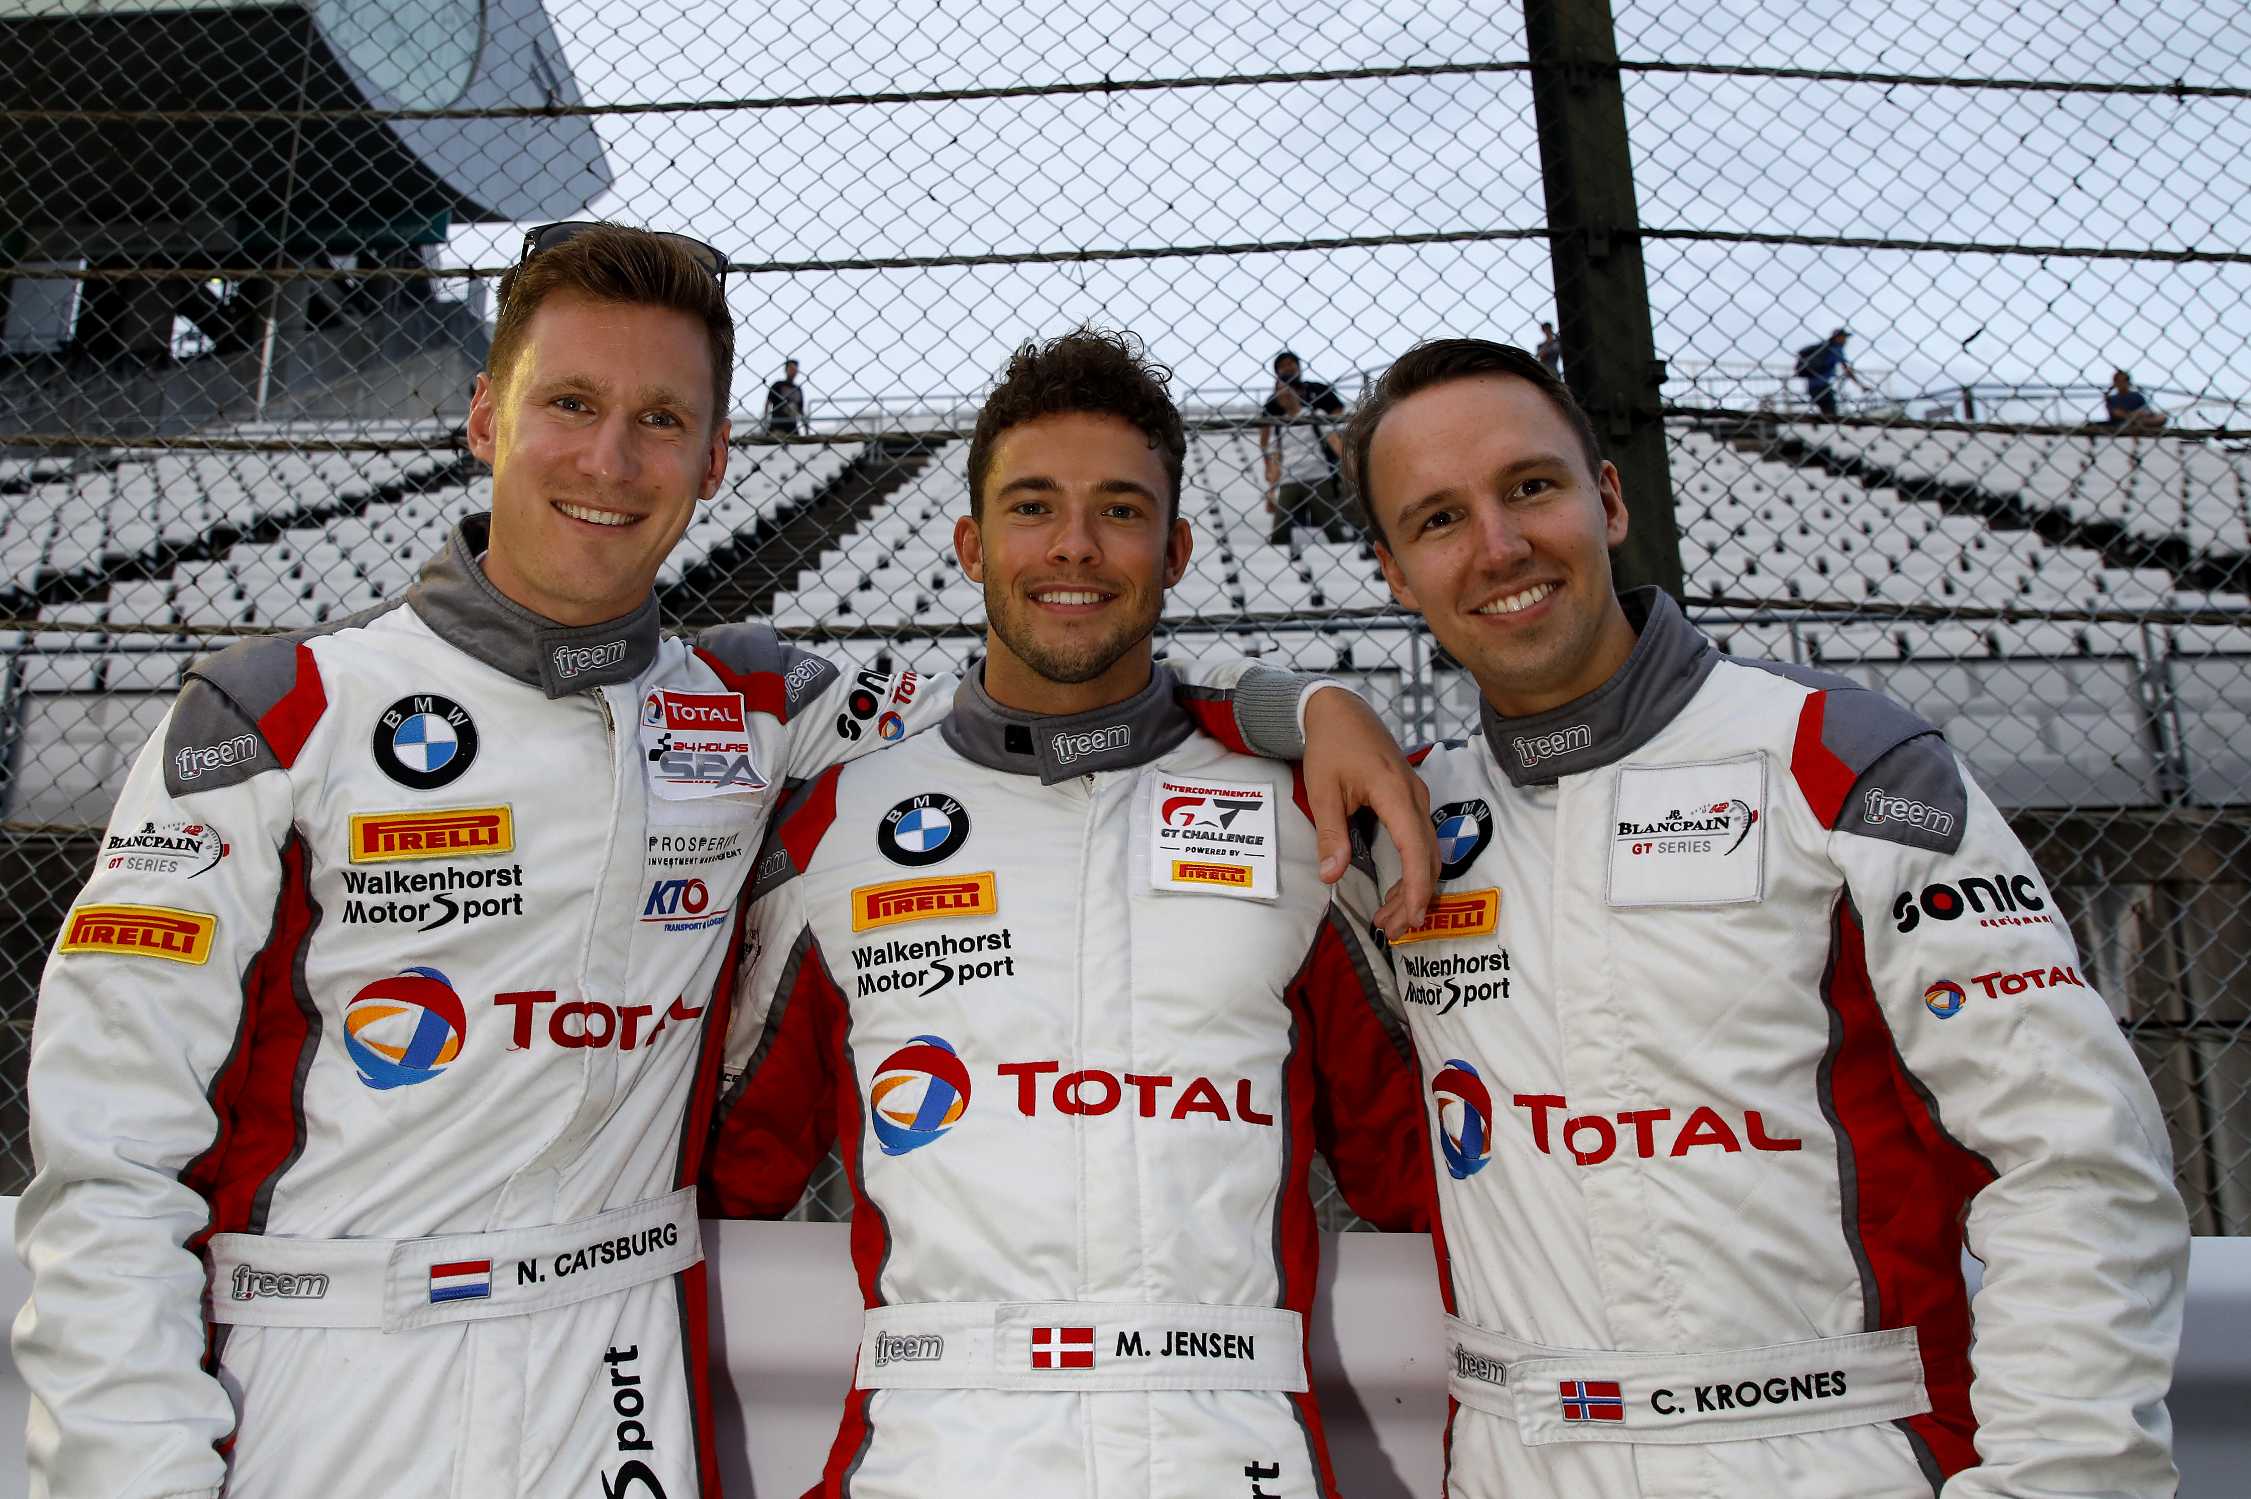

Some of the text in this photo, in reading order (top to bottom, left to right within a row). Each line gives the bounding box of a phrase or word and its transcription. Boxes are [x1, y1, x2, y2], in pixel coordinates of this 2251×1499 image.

[553, 640, 627, 678] freem
[383, 696, 469, 729] BMW
[667, 702, 738, 722] TOTAL
[175, 733, 259, 781] freem
[673, 742, 749, 753] 24 HOURS
[1052, 724, 1131, 765] freem
[1513, 724, 1592, 767] freem
[660, 752, 766, 789] SPA
[1162, 782, 1263, 798] INTERCONTINENTAL
[886, 795, 961, 825] BMW
[1433, 801, 1490, 824] BMW
[1617, 816, 1731, 836] BLANCPAIN
[1864, 788, 1954, 836] freem
[106, 835, 203, 853] BLANCPAIN
[362, 815, 500, 854] PIRELLI
[1161, 828, 1264, 846] GT CHALLENGE
[1185, 846, 1240, 857] POWERED BY
[1632, 840, 1712, 855] GT SERIES
[109, 857, 178, 873] GT SERIES
[342, 864, 523, 894] Walkenhorst
[1179, 863, 1246, 883] PIRELLI
[644, 878, 709, 915] KTO
[866, 882, 980, 920] PIRELLI
[70, 912, 198, 953] PIRELLI
[851, 928, 1012, 970] Walkenhorst
[1970, 966, 2085, 999] TOTAL
[997, 1060, 1274, 1127] TOTAL
[1513, 1093, 1803, 1167] TOTAL
[517, 1222, 678, 1286] N. CATSBURG
[231, 1264, 329, 1300] freem
[874, 1331, 944, 1367] freem
[1115, 1331, 1255, 1361] M. JENSEN
[1650, 1370, 1847, 1415] C. KROGNES
